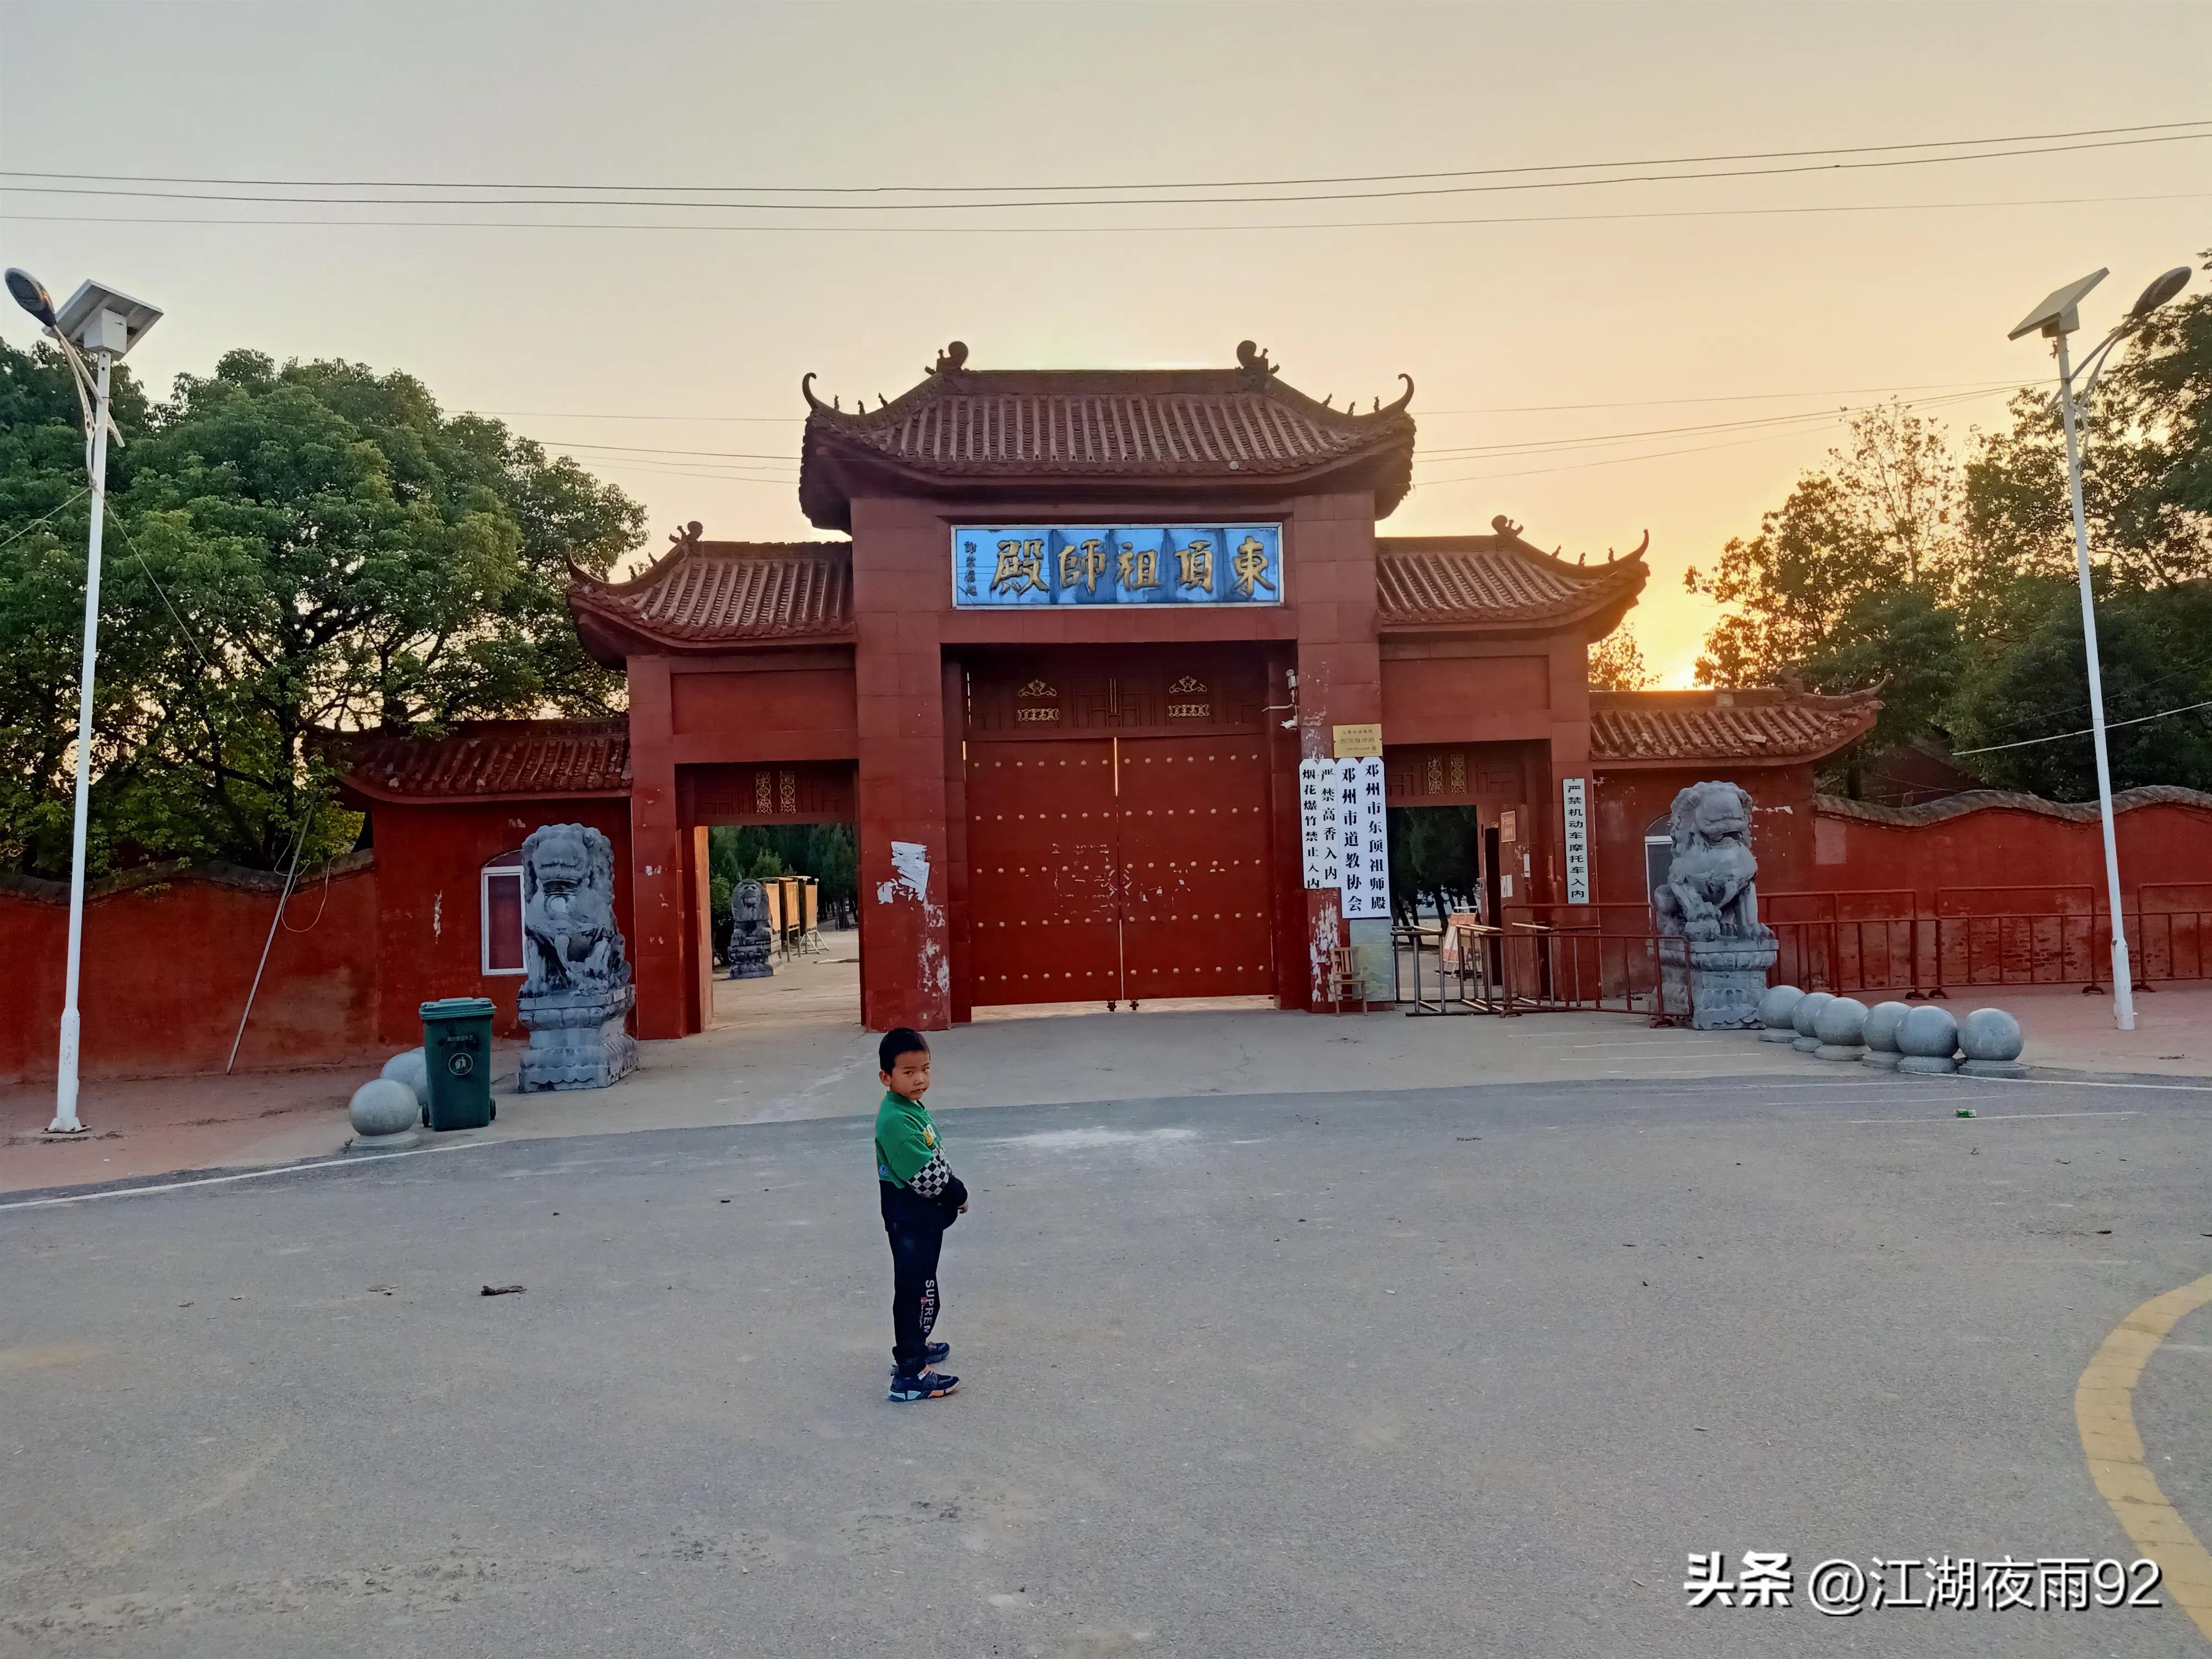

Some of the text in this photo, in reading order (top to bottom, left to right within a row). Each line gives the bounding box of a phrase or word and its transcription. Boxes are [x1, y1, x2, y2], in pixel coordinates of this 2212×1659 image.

[1302, 769, 1319, 888] 烟花爆竹禁止入内
[1321, 768, 1337, 880] 严禁高香入内
[1341, 767, 1362, 911] 邓州市道教协会
[1364, 764, 1385, 910] 邓州市东顶祖师殿
[1567, 785, 1585, 898] 严禁机动车摩托车入内
